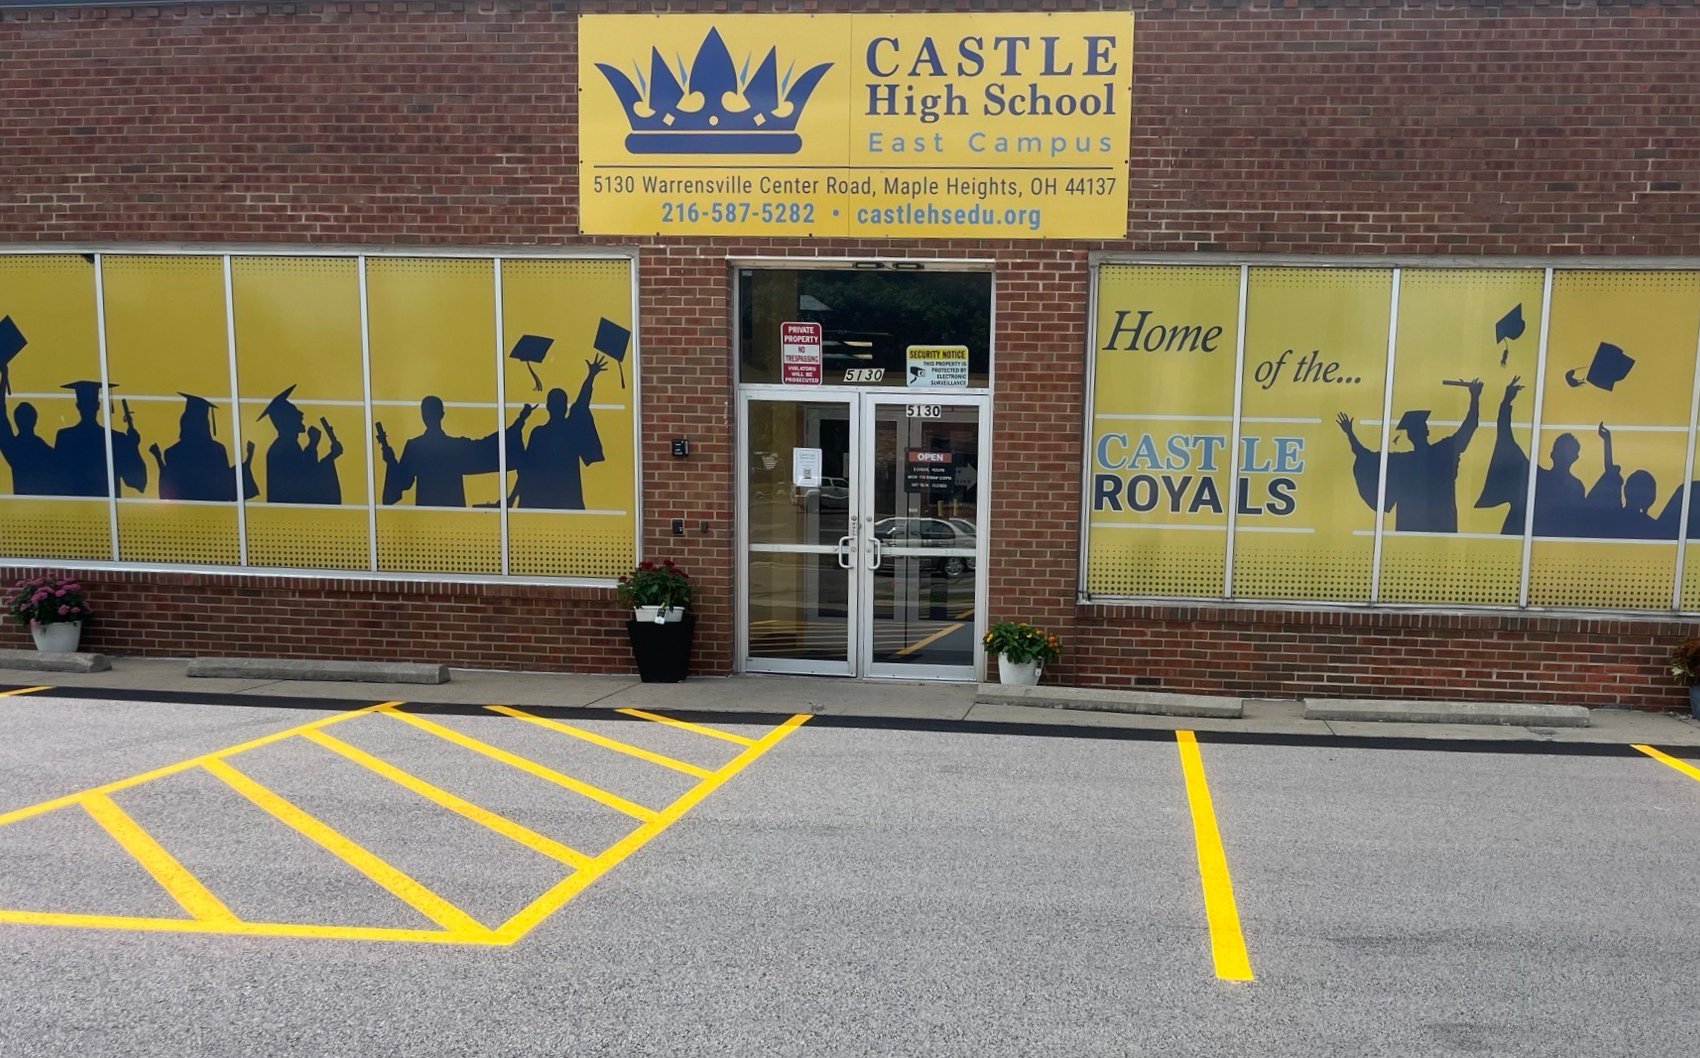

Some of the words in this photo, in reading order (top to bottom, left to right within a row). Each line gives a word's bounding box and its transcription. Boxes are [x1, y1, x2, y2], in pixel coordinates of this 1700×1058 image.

[866, 36, 1118, 77] CASTLE
[865, 83, 969, 123] High
[984, 82, 1117, 116] School
[868, 132, 944, 153] East
[968, 132, 1112, 157] Campus
[593, 175, 635, 194] 5130
[642, 175, 752, 195] Warrensville
[759, 176, 819, 195] Center
[826, 176, 877, 197] Road,
[884, 177, 939, 199] Maple
[946, 177, 1023, 200] Heights,
[1030, 177, 1058, 196] OH
[1065, 177, 1117, 196] 44137
[661, 202, 816, 224] 216-587-5282
[857, 203, 1042, 230] castlehsedu.org
[784, 335, 819, 343] PROPERTY
[788, 326, 815, 334] PRIVATE
[1101, 310, 1223, 353] Home
[785, 354, 819, 363] TRESPASSING
[909, 350, 940, 359] SECURITY
[942, 350, 966, 359] NOTICE
[845, 369, 883, 381] 5130
[1254, 349, 1293, 390] of
[1292, 350, 1362, 384] the...
[906, 405, 941, 417] 5130
[917, 453, 944, 462] OPEN
[1097, 433, 1305, 474] CASTLE
[1093, 473, 1298, 516] ROYALS
